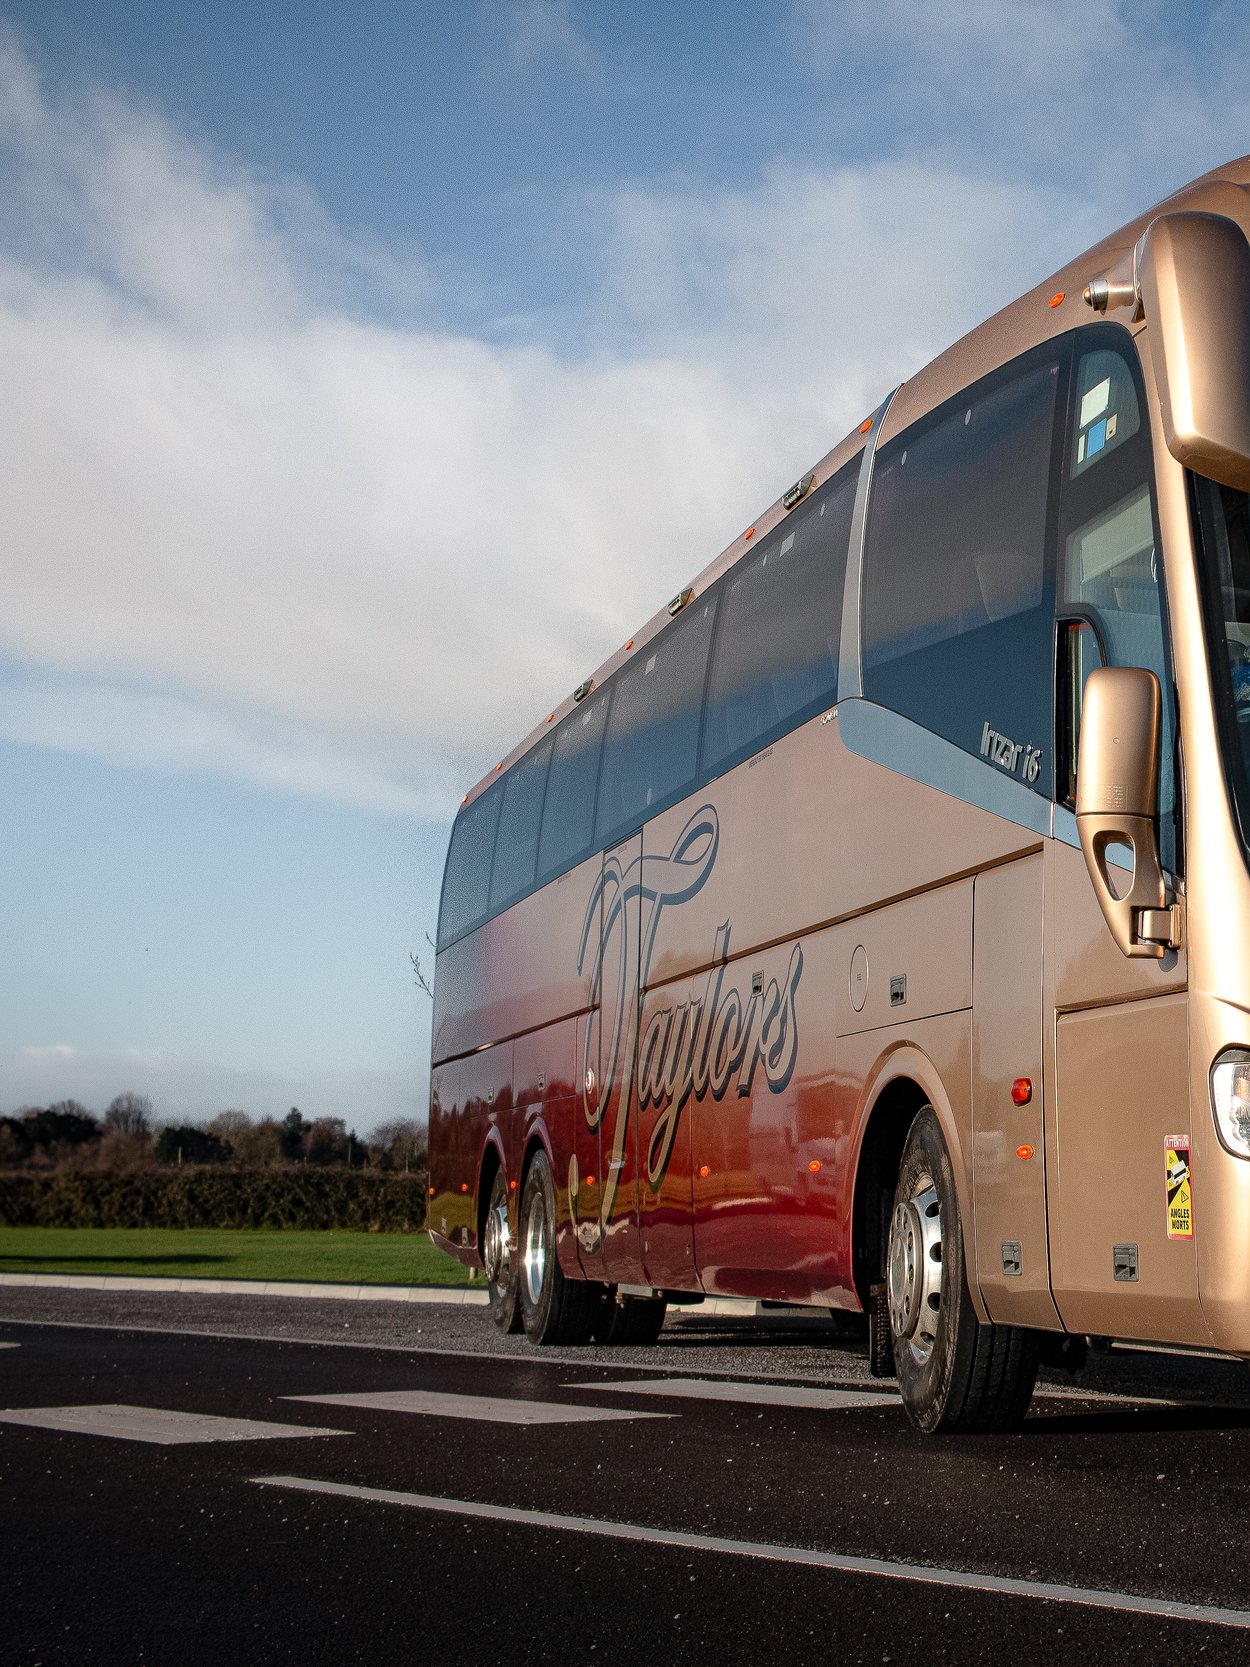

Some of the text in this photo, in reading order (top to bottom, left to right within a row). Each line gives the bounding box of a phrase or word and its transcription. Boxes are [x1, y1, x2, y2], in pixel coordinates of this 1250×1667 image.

[980, 721, 1043, 783] Irizar i6
[569, 804, 803, 1253] Taylors
[1165, 1138, 1190, 1148] ATTENTION
[1171, 1208, 1189, 1219] ANGLES
[1172, 1219, 1189, 1231] MORTS
